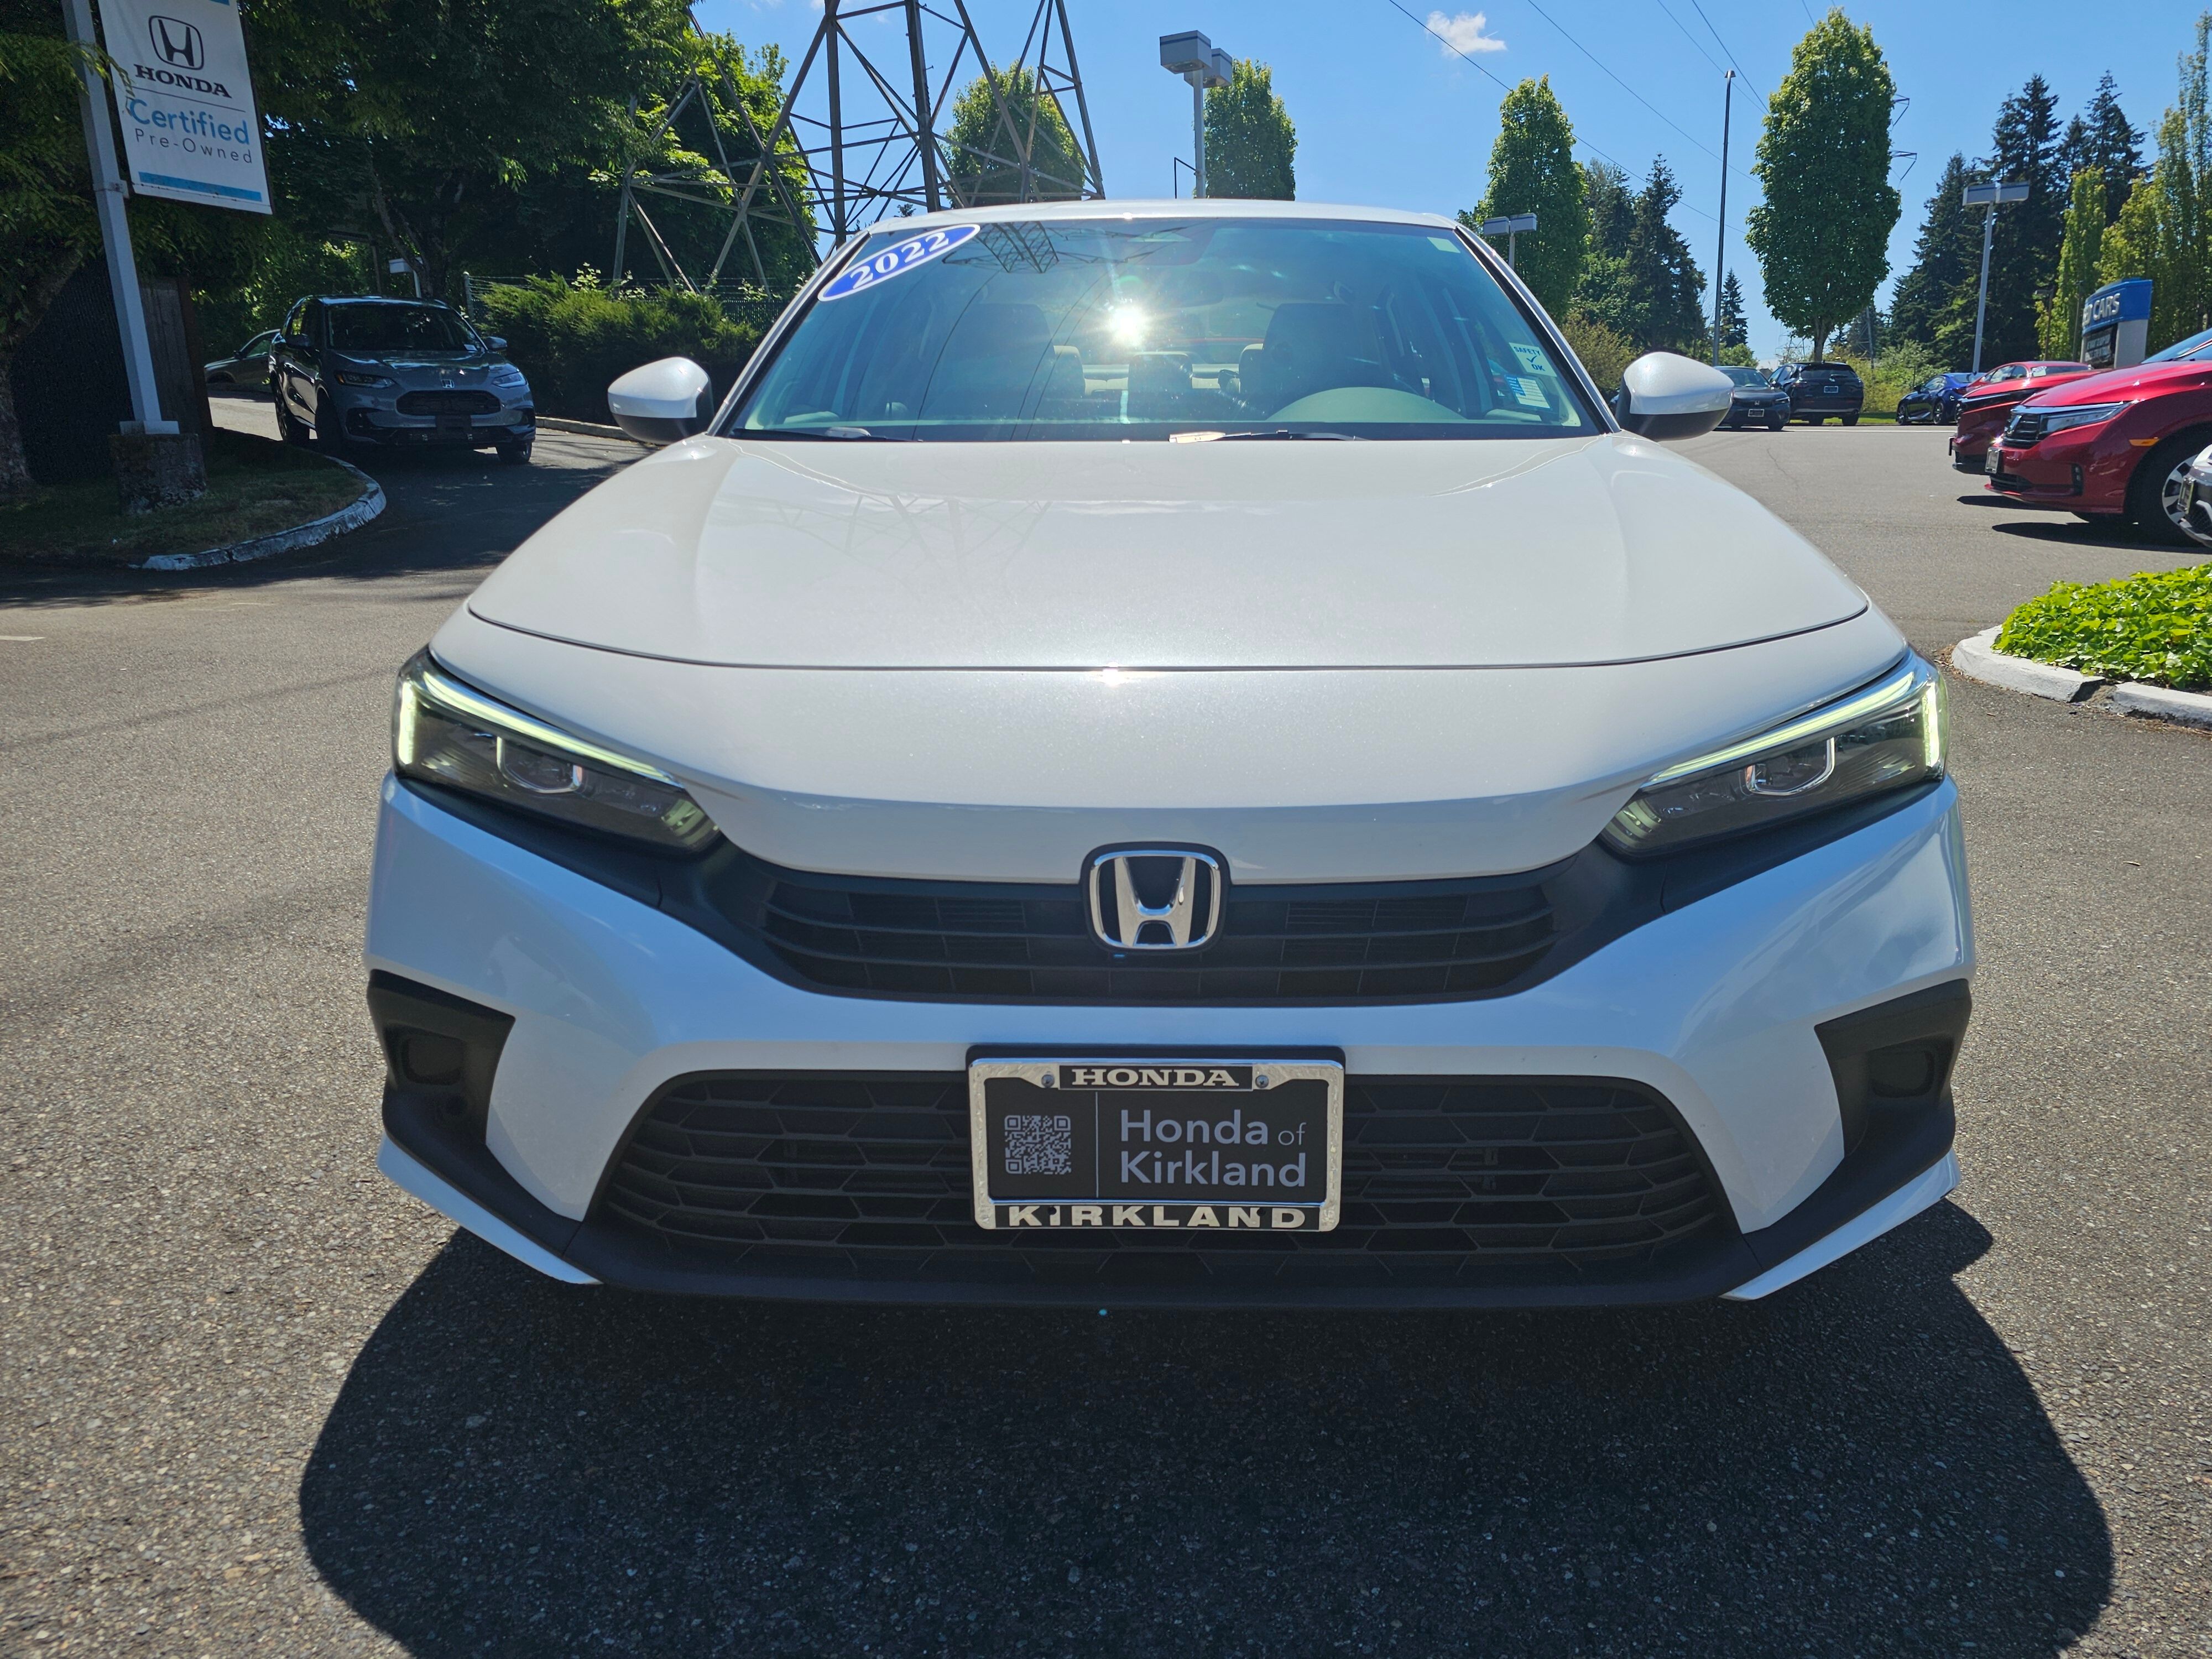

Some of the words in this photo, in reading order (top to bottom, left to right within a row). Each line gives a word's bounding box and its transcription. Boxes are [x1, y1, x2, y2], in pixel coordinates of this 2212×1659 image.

[134, 64, 232, 98] HONDA
[130, 99, 249, 144] Certified
[135, 128, 252, 163] Pre-Owned
[850, 232, 948, 289] 2022
[2093, 293, 2120, 320] CARS
[1514, 346, 1540, 356] SAFETY
[1072, 1069, 1239, 1087] HONDA
[1120, 1109, 1269, 1145] Honda
[1277, 1122, 1306, 1146] of
[1120, 1150, 1306, 1187] Kirkland
[1009, 1206, 1306, 1229] KIRKLAND
